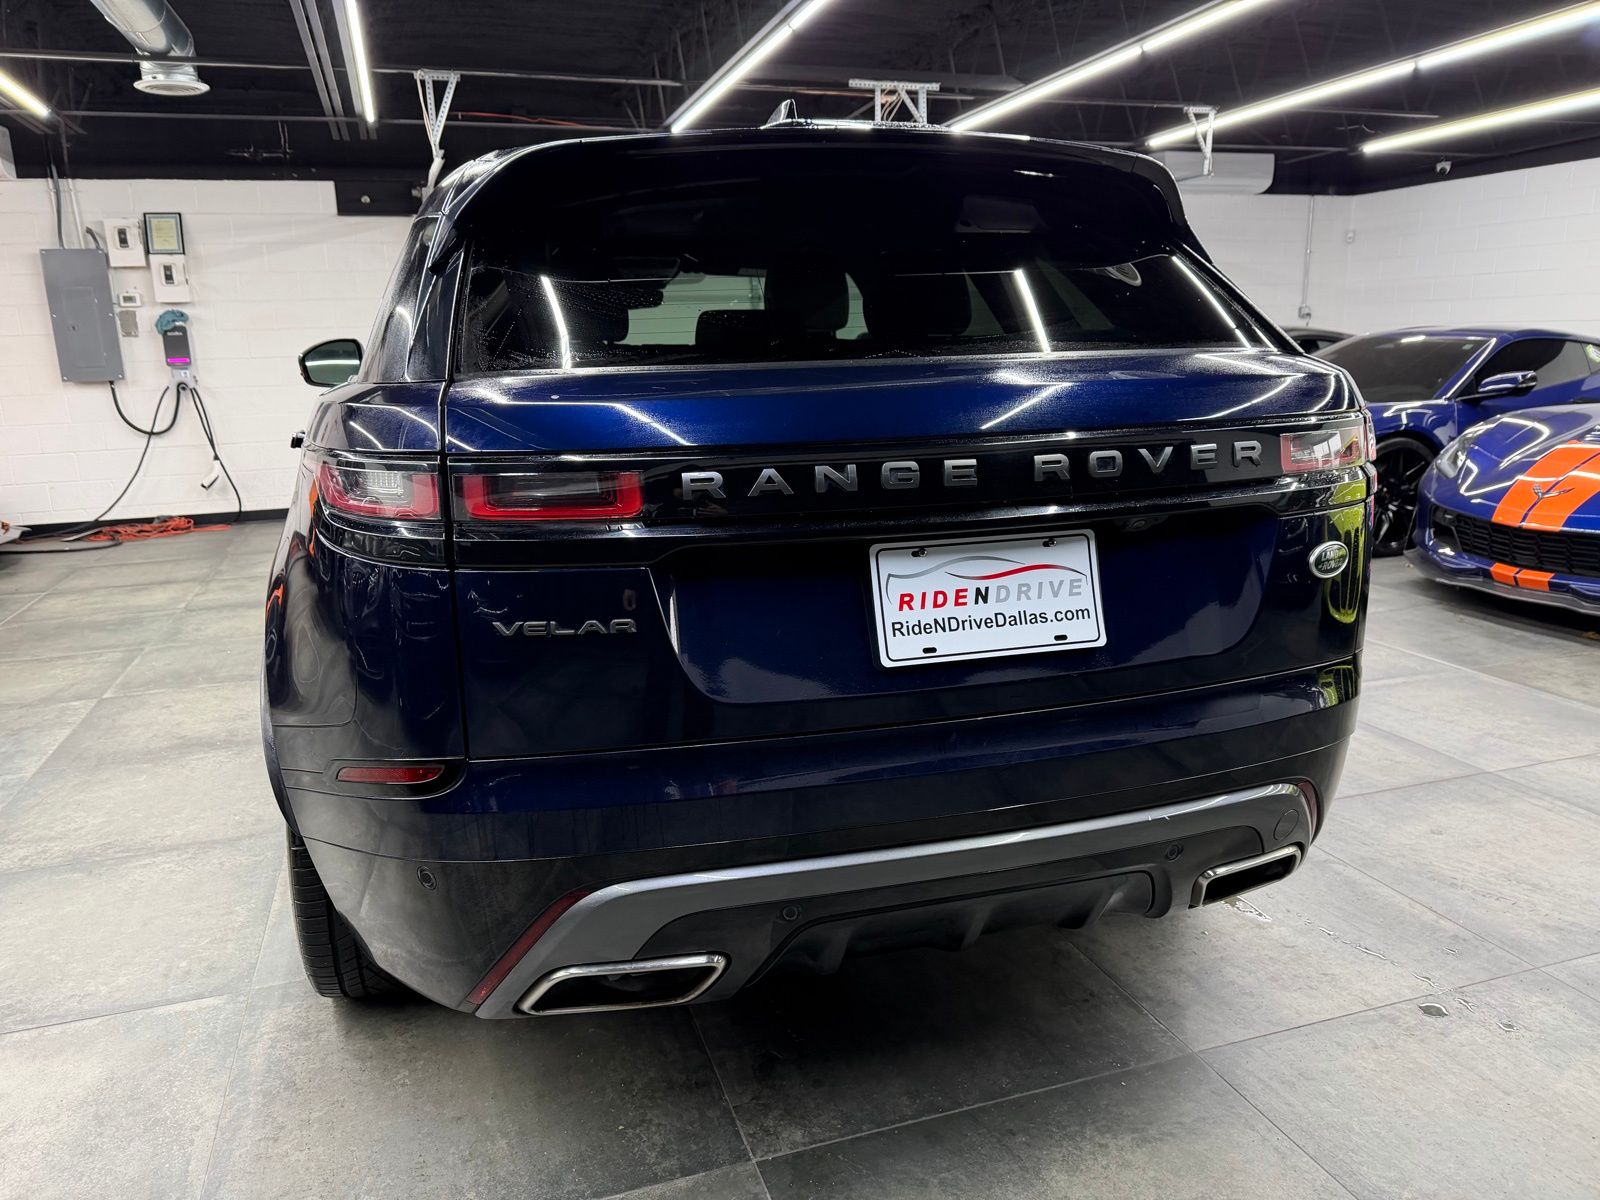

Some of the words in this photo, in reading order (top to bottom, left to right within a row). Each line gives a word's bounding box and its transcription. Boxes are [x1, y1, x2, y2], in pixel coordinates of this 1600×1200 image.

[681, 458, 978, 501] RANGE
[1034, 439, 1262, 482] ROVER
[898, 578, 1083, 612] RIDENDRIVE
[492, 618, 637, 637] VELAR
[891, 607, 1091, 638] RideNDriveDallas.com
